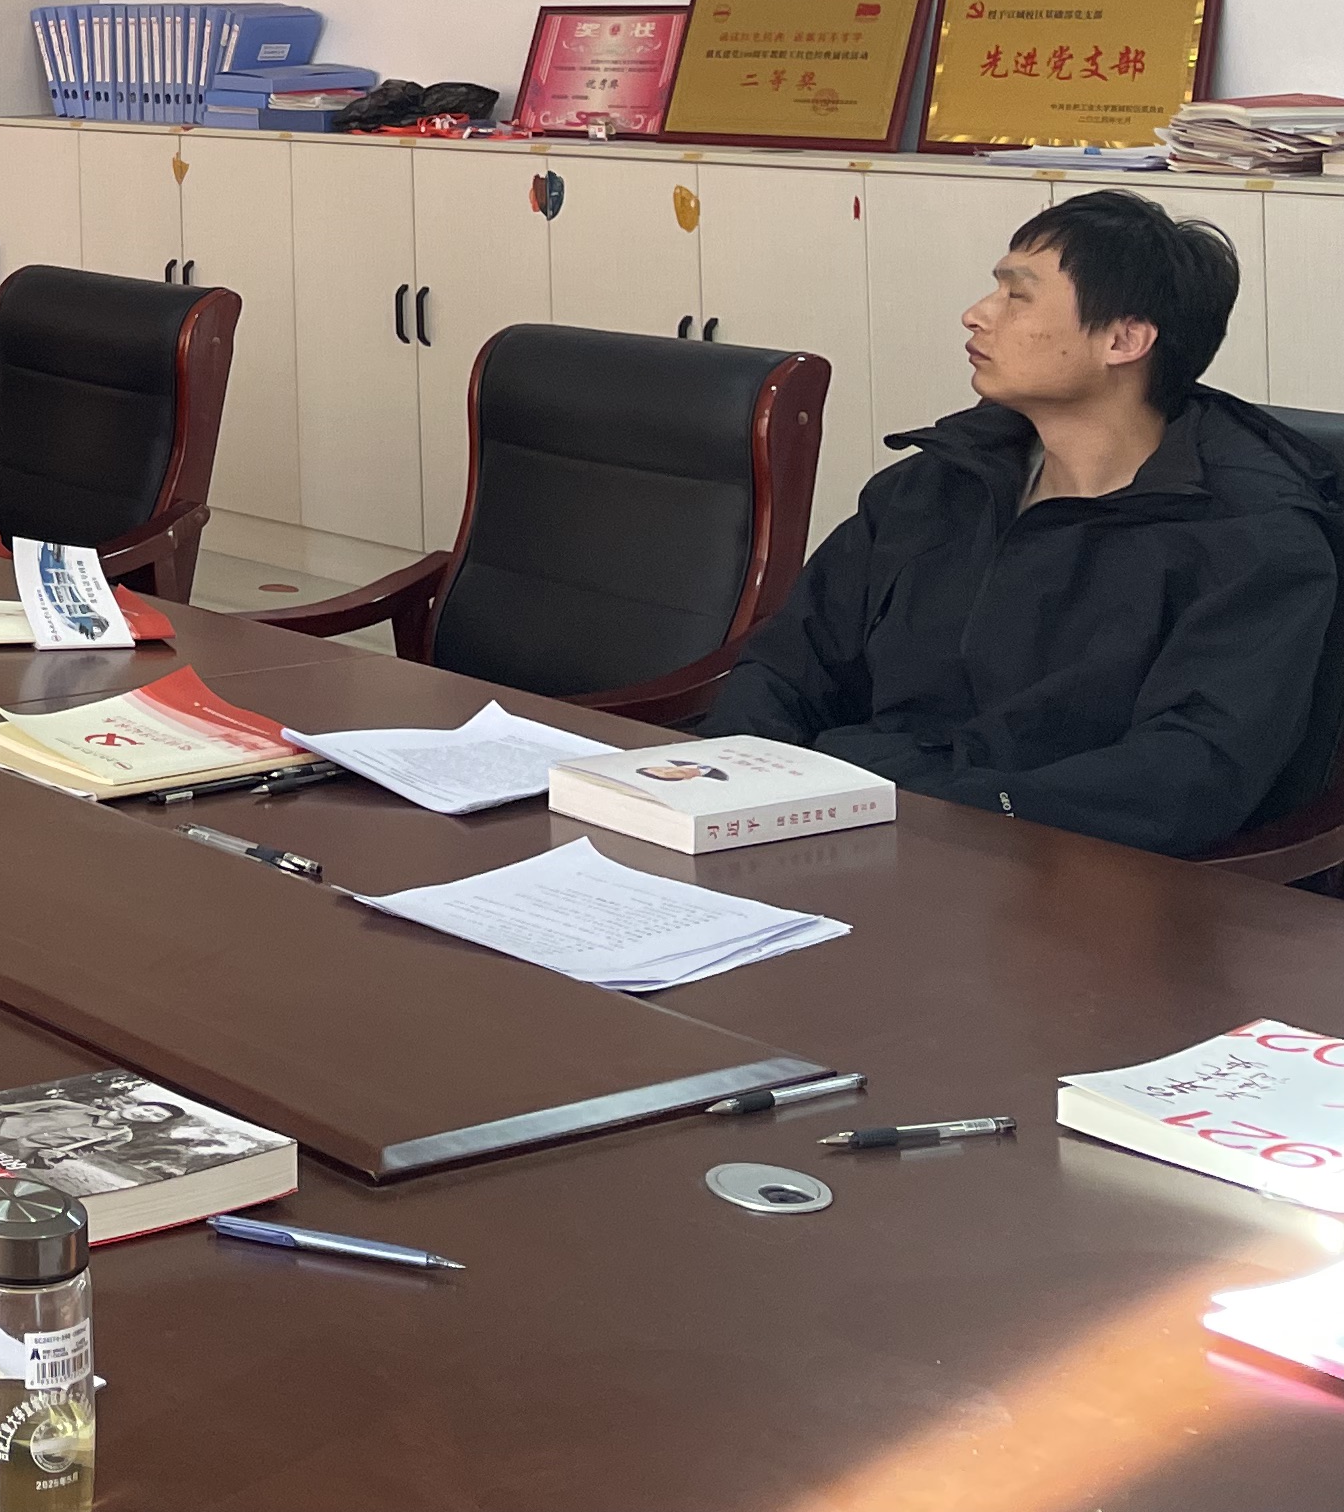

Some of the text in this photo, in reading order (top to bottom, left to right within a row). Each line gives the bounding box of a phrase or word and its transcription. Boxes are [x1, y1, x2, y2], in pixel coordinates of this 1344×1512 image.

[980, 44, 1146, 82] 先进党支部
[739, 69, 817, 91] 二等奖
[707, 817, 762, 841] 习近平
